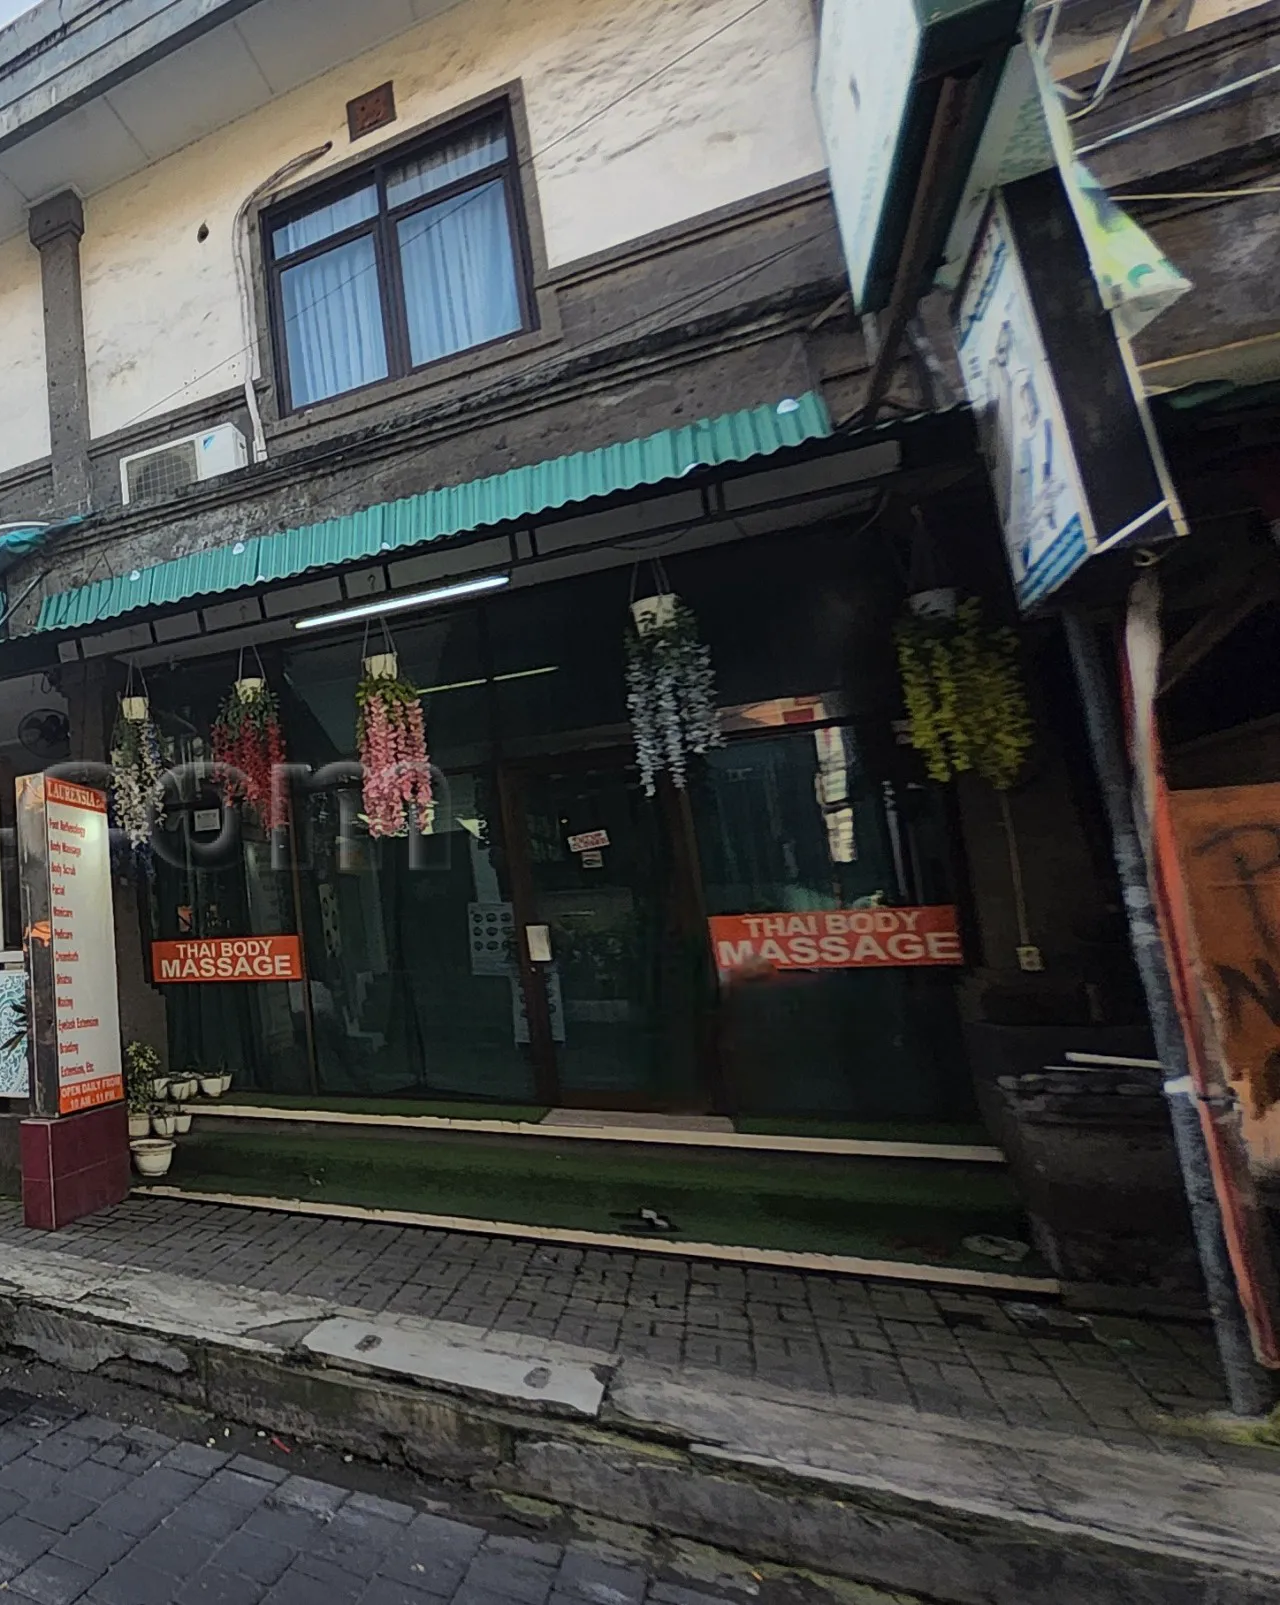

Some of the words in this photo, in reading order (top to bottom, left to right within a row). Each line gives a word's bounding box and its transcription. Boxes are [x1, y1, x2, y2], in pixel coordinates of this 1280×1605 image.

[50, 840, 61, 854] Body
[51, 862, 61, 876] Body
[63, 864, 76, 876] Scrub
[52, 883, 65, 896] Facial
[741, 917, 819, 938] THAI
[824, 911, 921, 935] BODY
[176, 943, 216, 959] THAI
[221, 940, 273, 957] BODY
[717, 931, 963, 966] MASSAGE
[161, 954, 293, 979] MASSAGE
[61, 1085, 81, 1098] OPEN
[81, 1080, 101, 1094] DAILY
[102, 1075, 121, 1088] FROM
